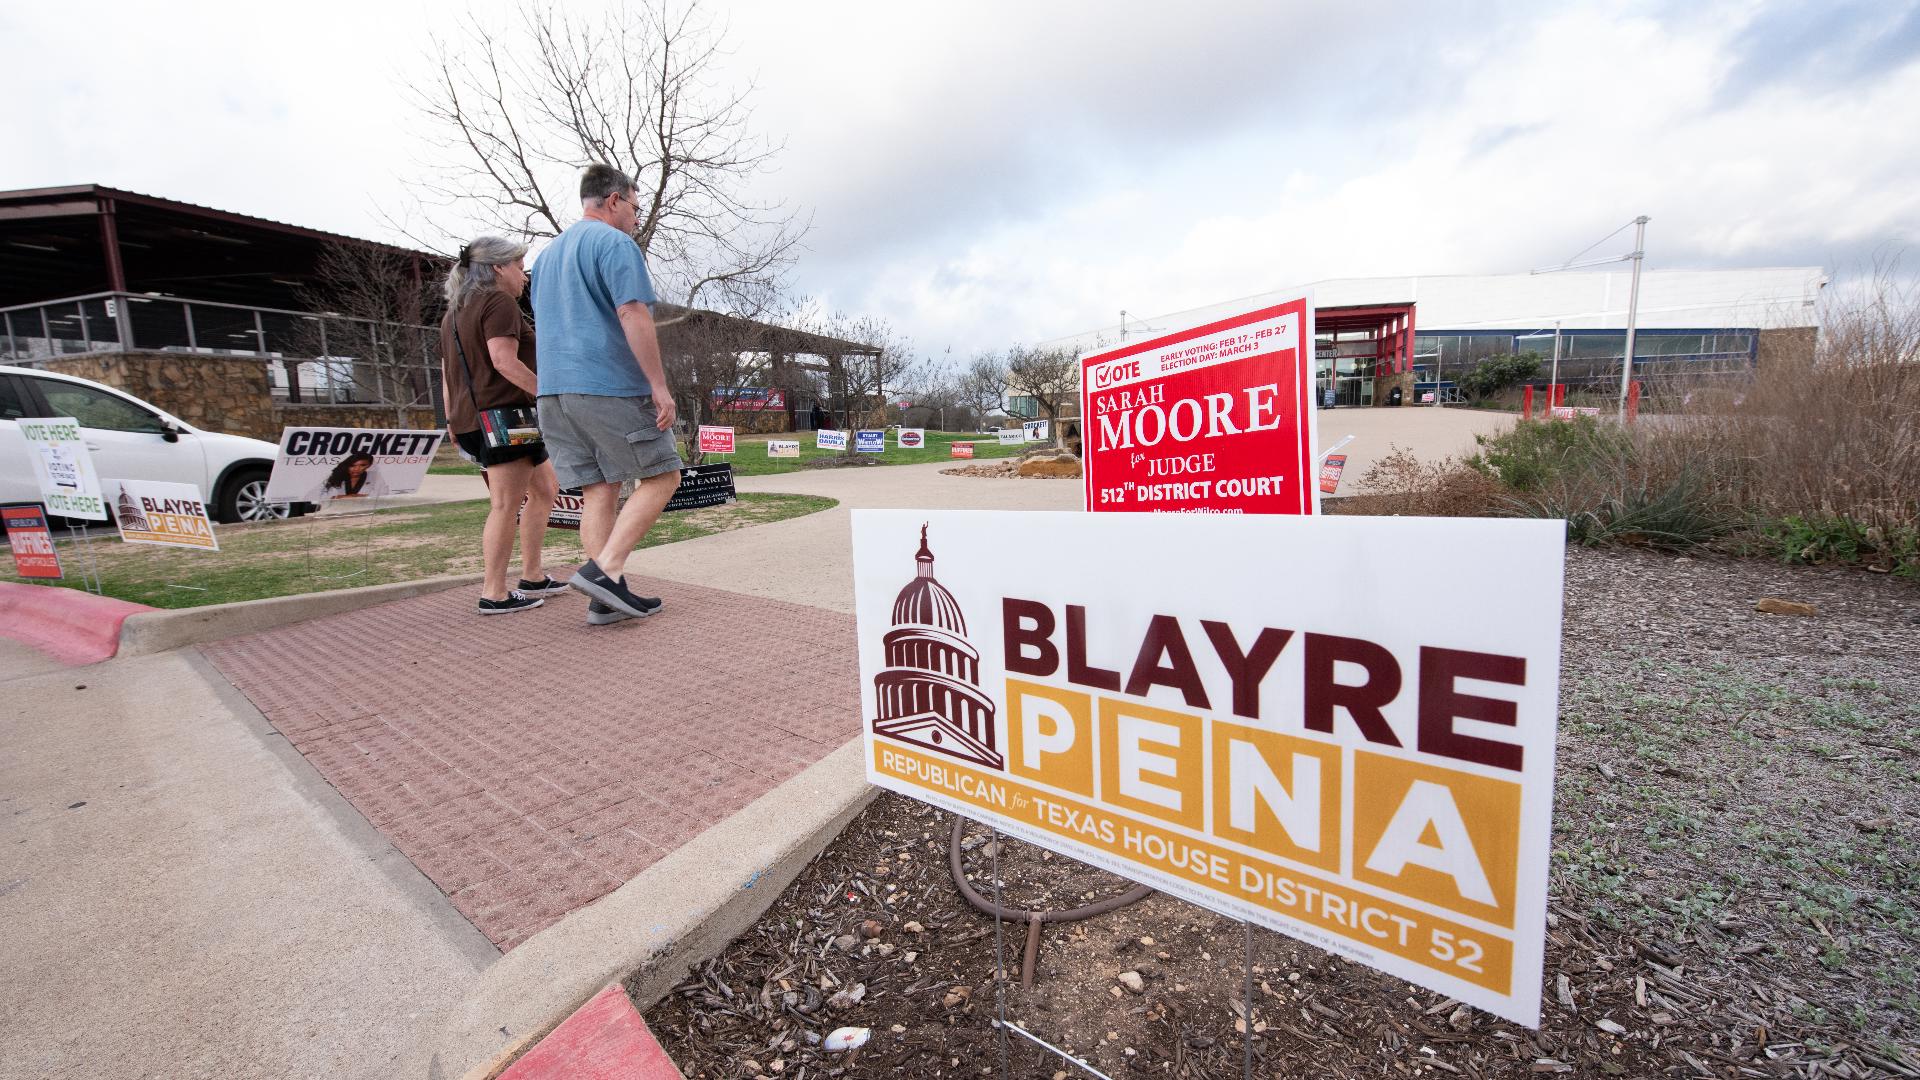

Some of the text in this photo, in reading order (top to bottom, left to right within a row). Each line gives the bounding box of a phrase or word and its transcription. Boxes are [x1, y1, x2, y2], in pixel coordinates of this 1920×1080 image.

[1160, 351, 1183, 363] EARLY
[1185, 342, 1218, 358] VOTING:
[1220, 337, 1235, 348] FEB
[1237, 334, 1248, 345] 17
[1255, 328, 1273, 340] FEB
[1274, 324, 1287, 335] 27
[1160, 341, 1259, 371] ELECTION DAY: MARCH 3
[1096, 383, 1165, 414] SARAH
[1096, 382, 1281, 452] MOORE
[21, 424, 81, 441] VOTE HERE
[286, 430, 441, 456] CROCKETT
[284, 456, 430, 466] TEXAS TOUGH
[1130, 451, 1216, 477] for JUDGE
[697, 475, 729, 485] EARLY
[1137, 480, 1211, 503] DISTRICT
[1215, 475, 1284, 498] COURT
[47, 494, 102, 513] VOTE HERE
[141, 496, 204, 517] BLAYRE
[150, 514, 211, 537] PENA
[1002, 596, 1527, 772] BLAYRE
[1020, 692, 1499, 909] PENA
[882, 750, 1006, 807] REPUBLICAN
[1008, 791, 1029, 811] for
[1032, 796, 1115, 844] TEXAS
[1123, 825, 1230, 884] HOUSE
[1240, 864, 1418, 946] DISTRICT
[1429, 928, 1484, 974] 52
